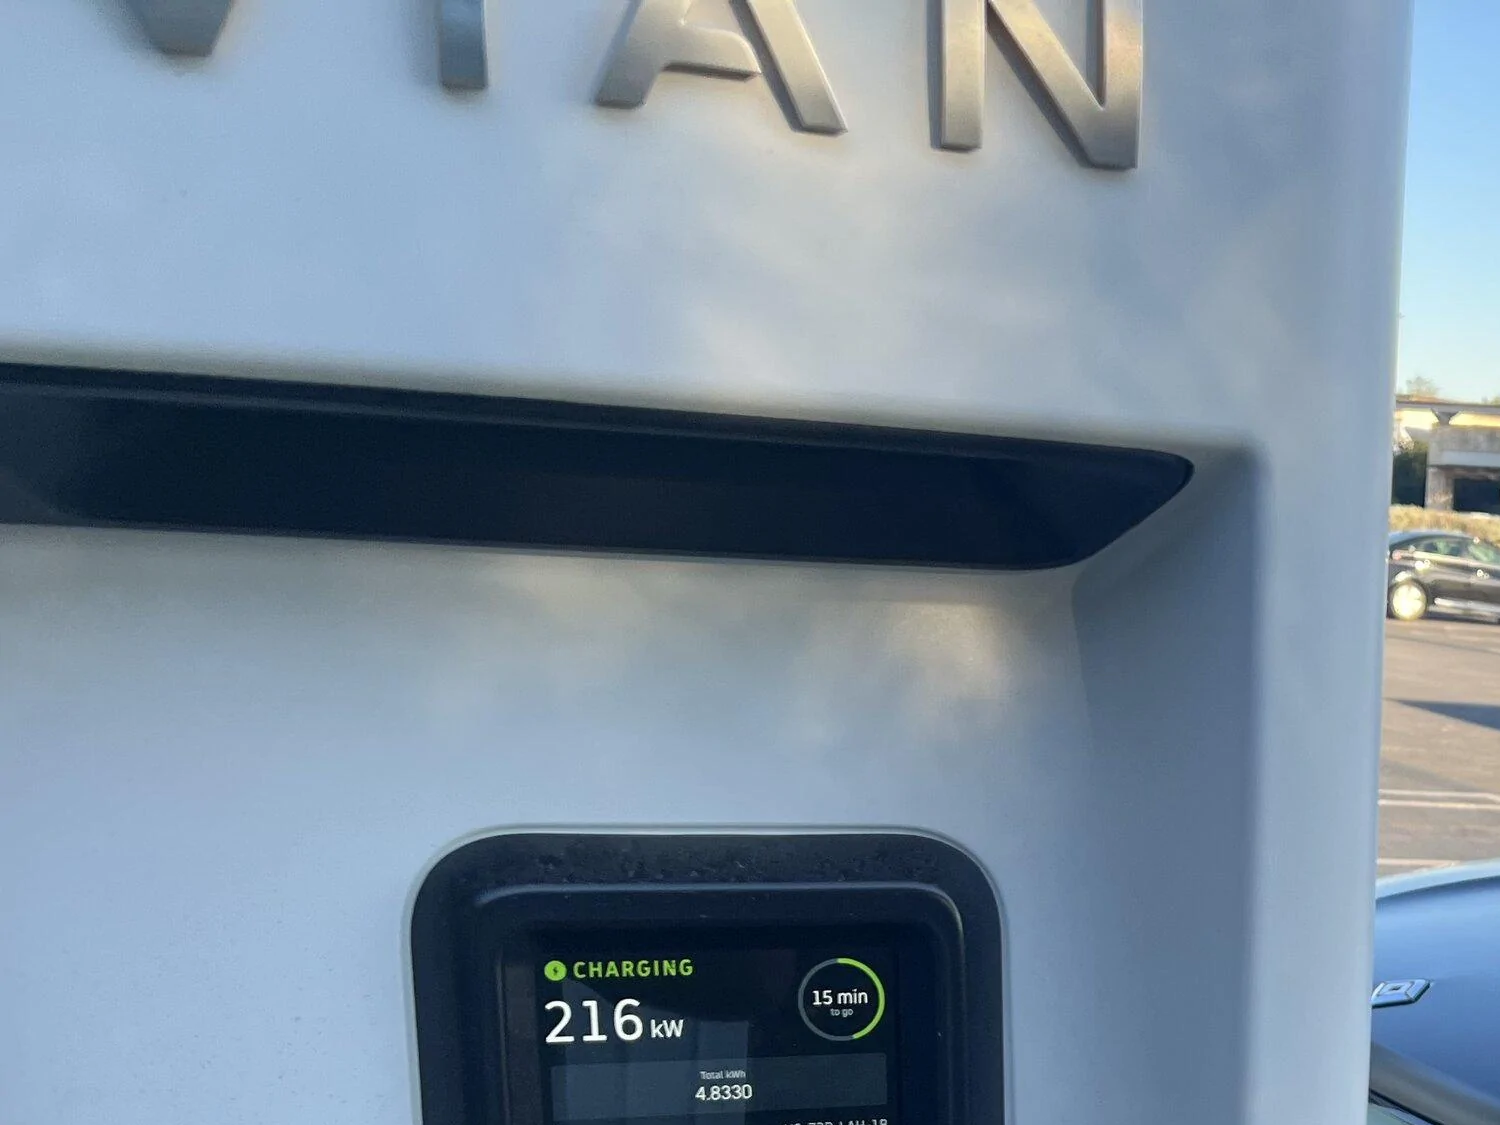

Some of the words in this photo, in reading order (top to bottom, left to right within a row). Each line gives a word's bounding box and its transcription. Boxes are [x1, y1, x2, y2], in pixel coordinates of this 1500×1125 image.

[573, 958, 694, 979] CHARGING
[811, 990, 834, 1006] 15
[837, 987, 868, 1005] min
[544, 997, 644, 1045] 216
[650, 1018, 684, 1039] kW
[830, 1007, 840, 1016] to
[842, 1008, 854, 1017] go
[700, 1070, 723, 1080] Total
[726, 1069, 746, 1078] kWh
[695, 1083, 753, 1101] 4.8330
